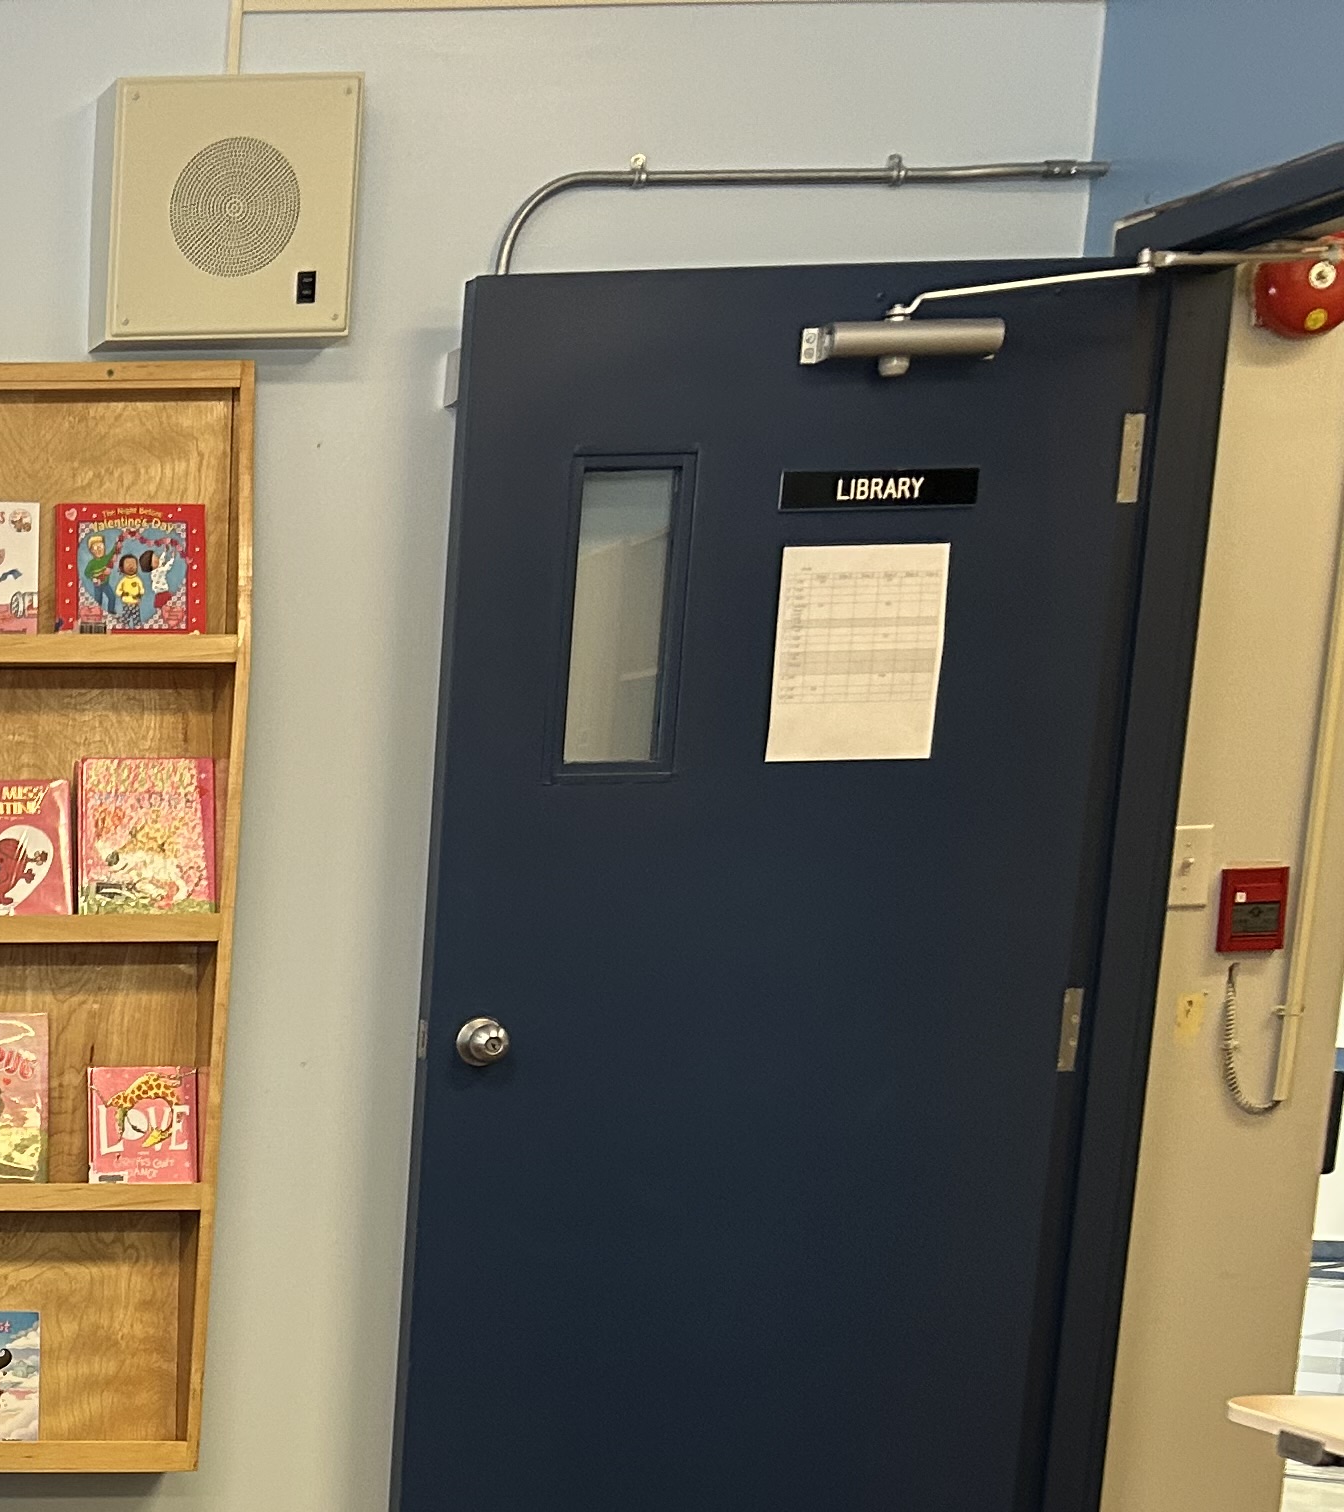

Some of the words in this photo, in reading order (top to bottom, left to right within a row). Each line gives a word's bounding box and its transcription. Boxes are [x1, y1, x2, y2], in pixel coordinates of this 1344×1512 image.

[836, 477, 924, 501] LIBRARY
[91, 516, 149, 533] Valentine's
[152, 517, 175, 534] Day
